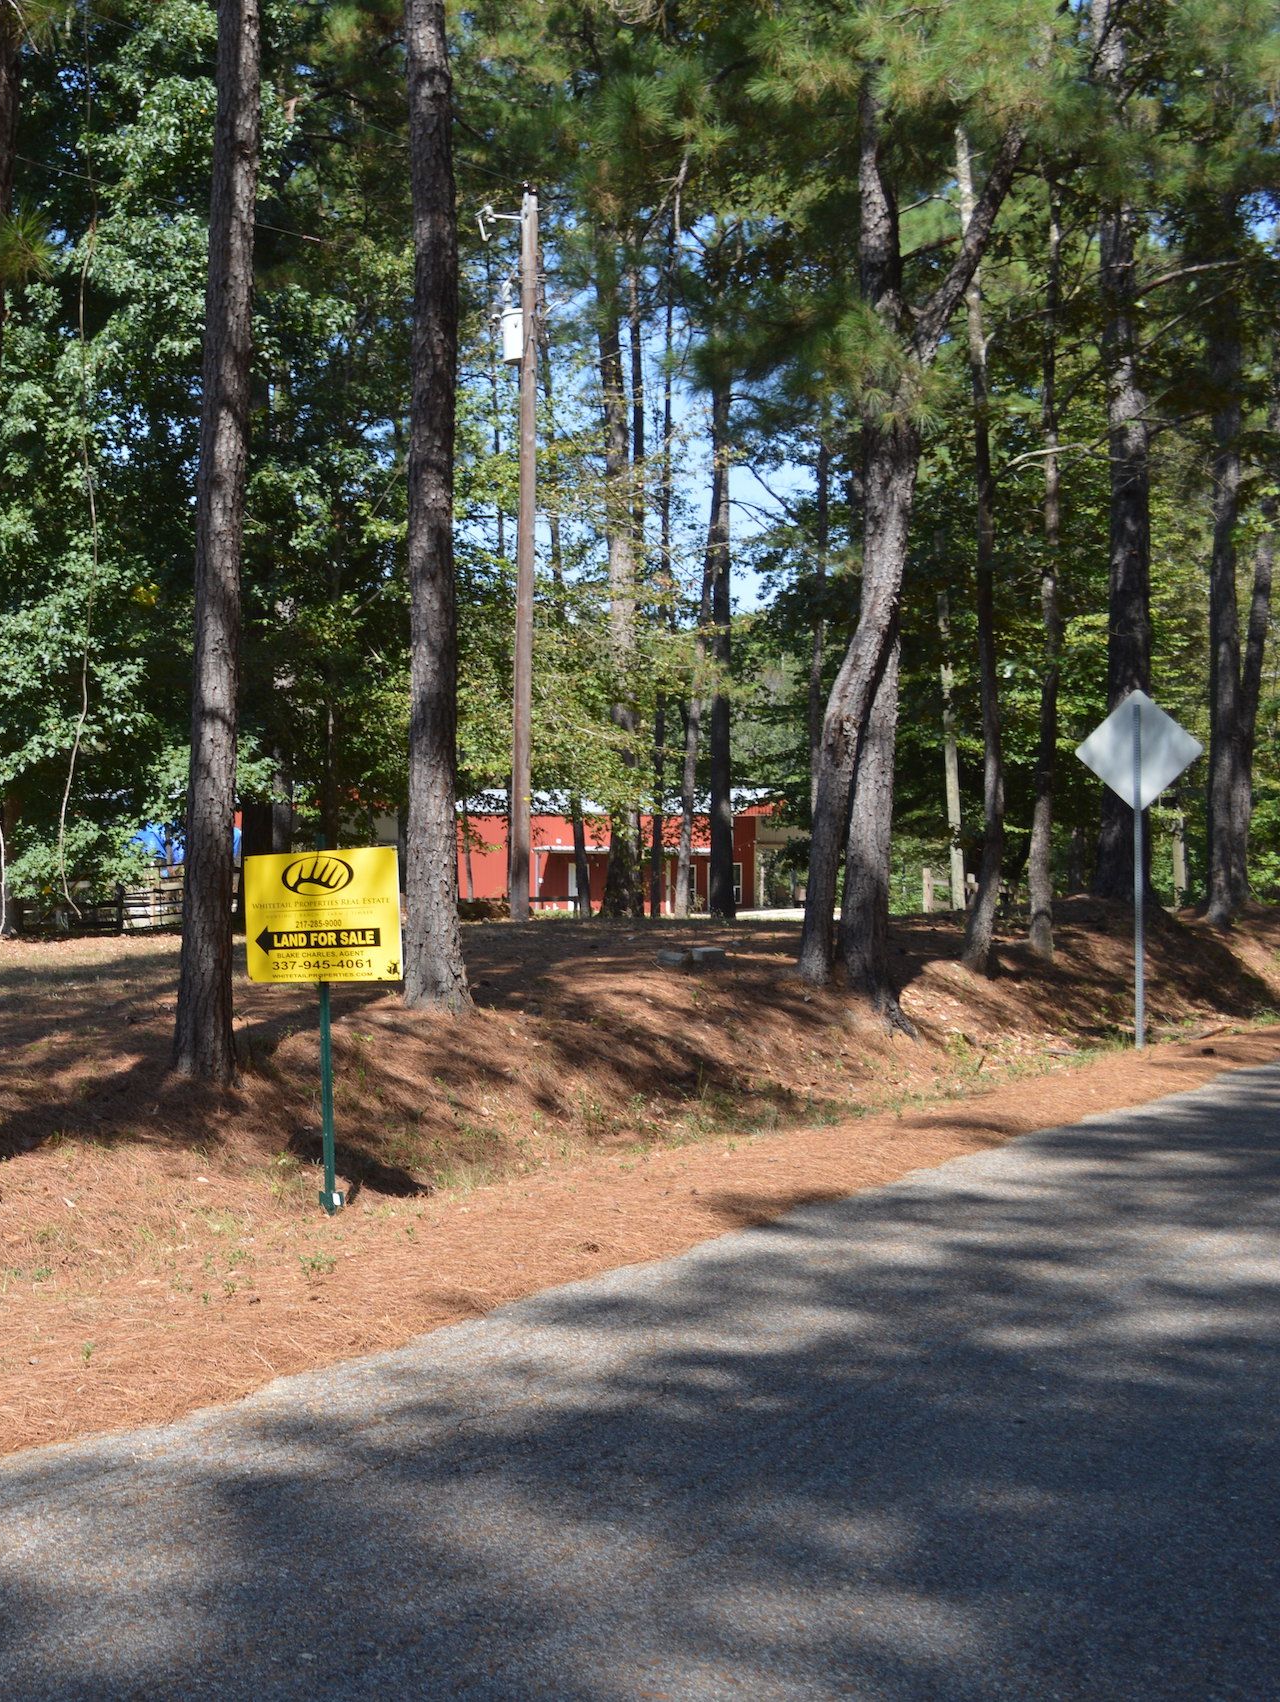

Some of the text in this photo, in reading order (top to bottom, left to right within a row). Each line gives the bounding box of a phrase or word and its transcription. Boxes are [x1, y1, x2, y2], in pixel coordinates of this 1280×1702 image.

[294, 899, 339, 908] PROPERTIES
[295, 919, 342, 928] 217-285-9000
[274, 930, 375, 947] LAND FOR SALE
[272, 959, 373, 971] 337-945-4061
[272, 972, 373, 980] WHITETAILPROPERTIES.COM
